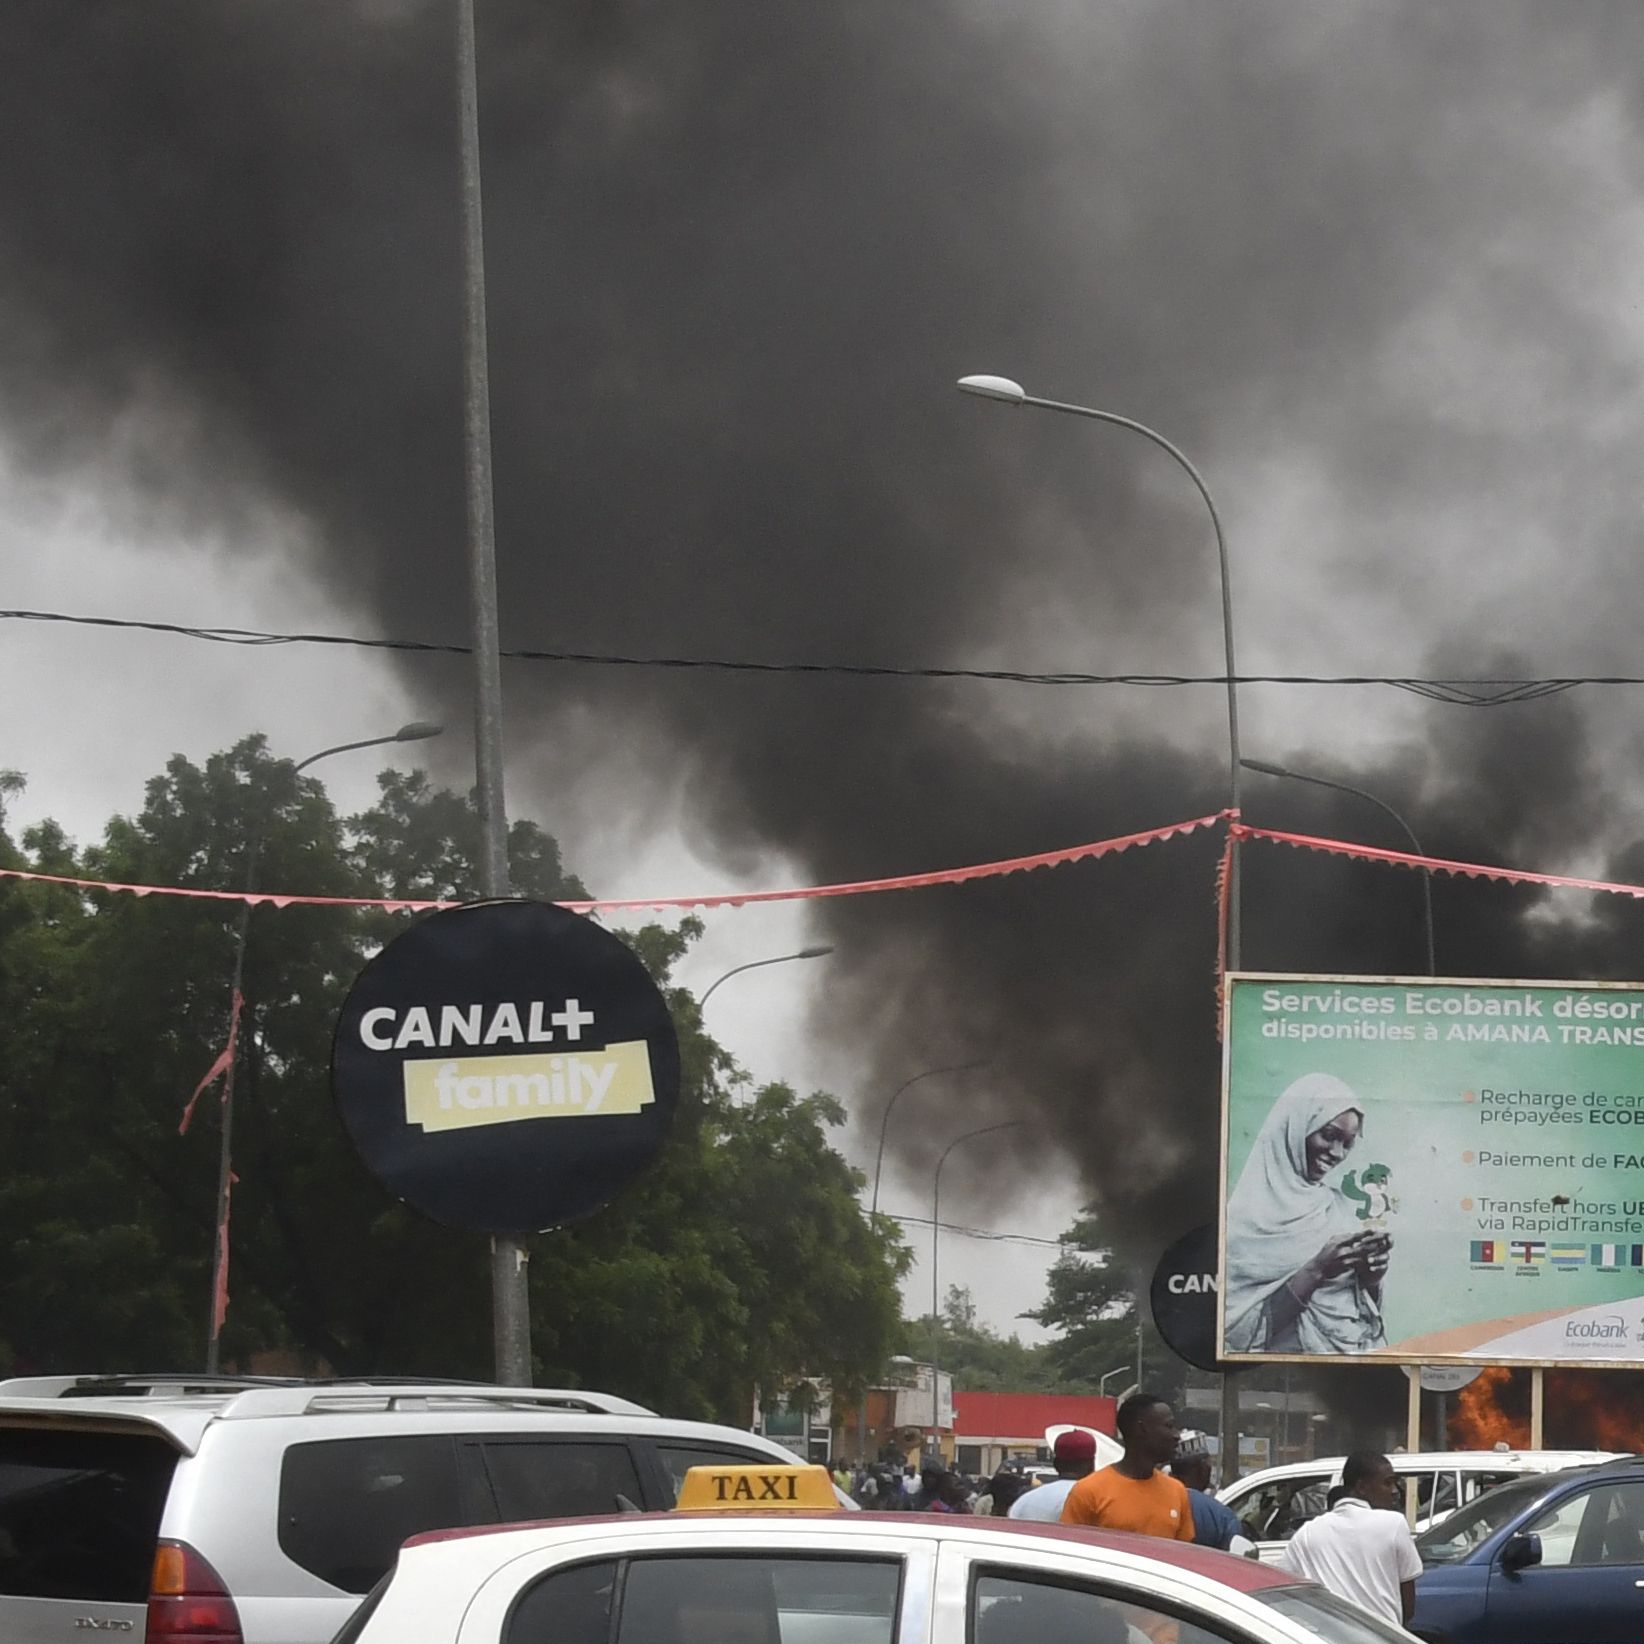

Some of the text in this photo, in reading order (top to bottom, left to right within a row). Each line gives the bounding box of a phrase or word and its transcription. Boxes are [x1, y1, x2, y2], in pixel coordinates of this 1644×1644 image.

[1262, 989, 1395, 1015] Services
[1405, 992, 1543, 1018] Ecobank
[360, 998, 594, 1051] CANAL+
[1262, 1018, 1416, 1042] disponibles
[1424, 1022, 1439, 1041] à
[1446, 1023, 1551, 1044] AMANA
[434, 1058, 618, 1112] family
[1481, 1089, 1576, 1110] Recharge
[1582, 1092, 1607, 1107] de
[1480, 1107, 1583, 1126] prépayées
[1479, 1151, 1575, 1168] Paiement
[1581, 1153, 1607, 1169] de
[1478, 1197, 1567, 1214] Transfert
[1573, 1200, 1616, 1215] hors
[1477, 1216, 1505, 1231] via
[1167, 1273, 1219, 1294] CAN
[1565, 1315, 1630, 1339] Ecobank
[711, 1474, 799, 1501] TAXI
